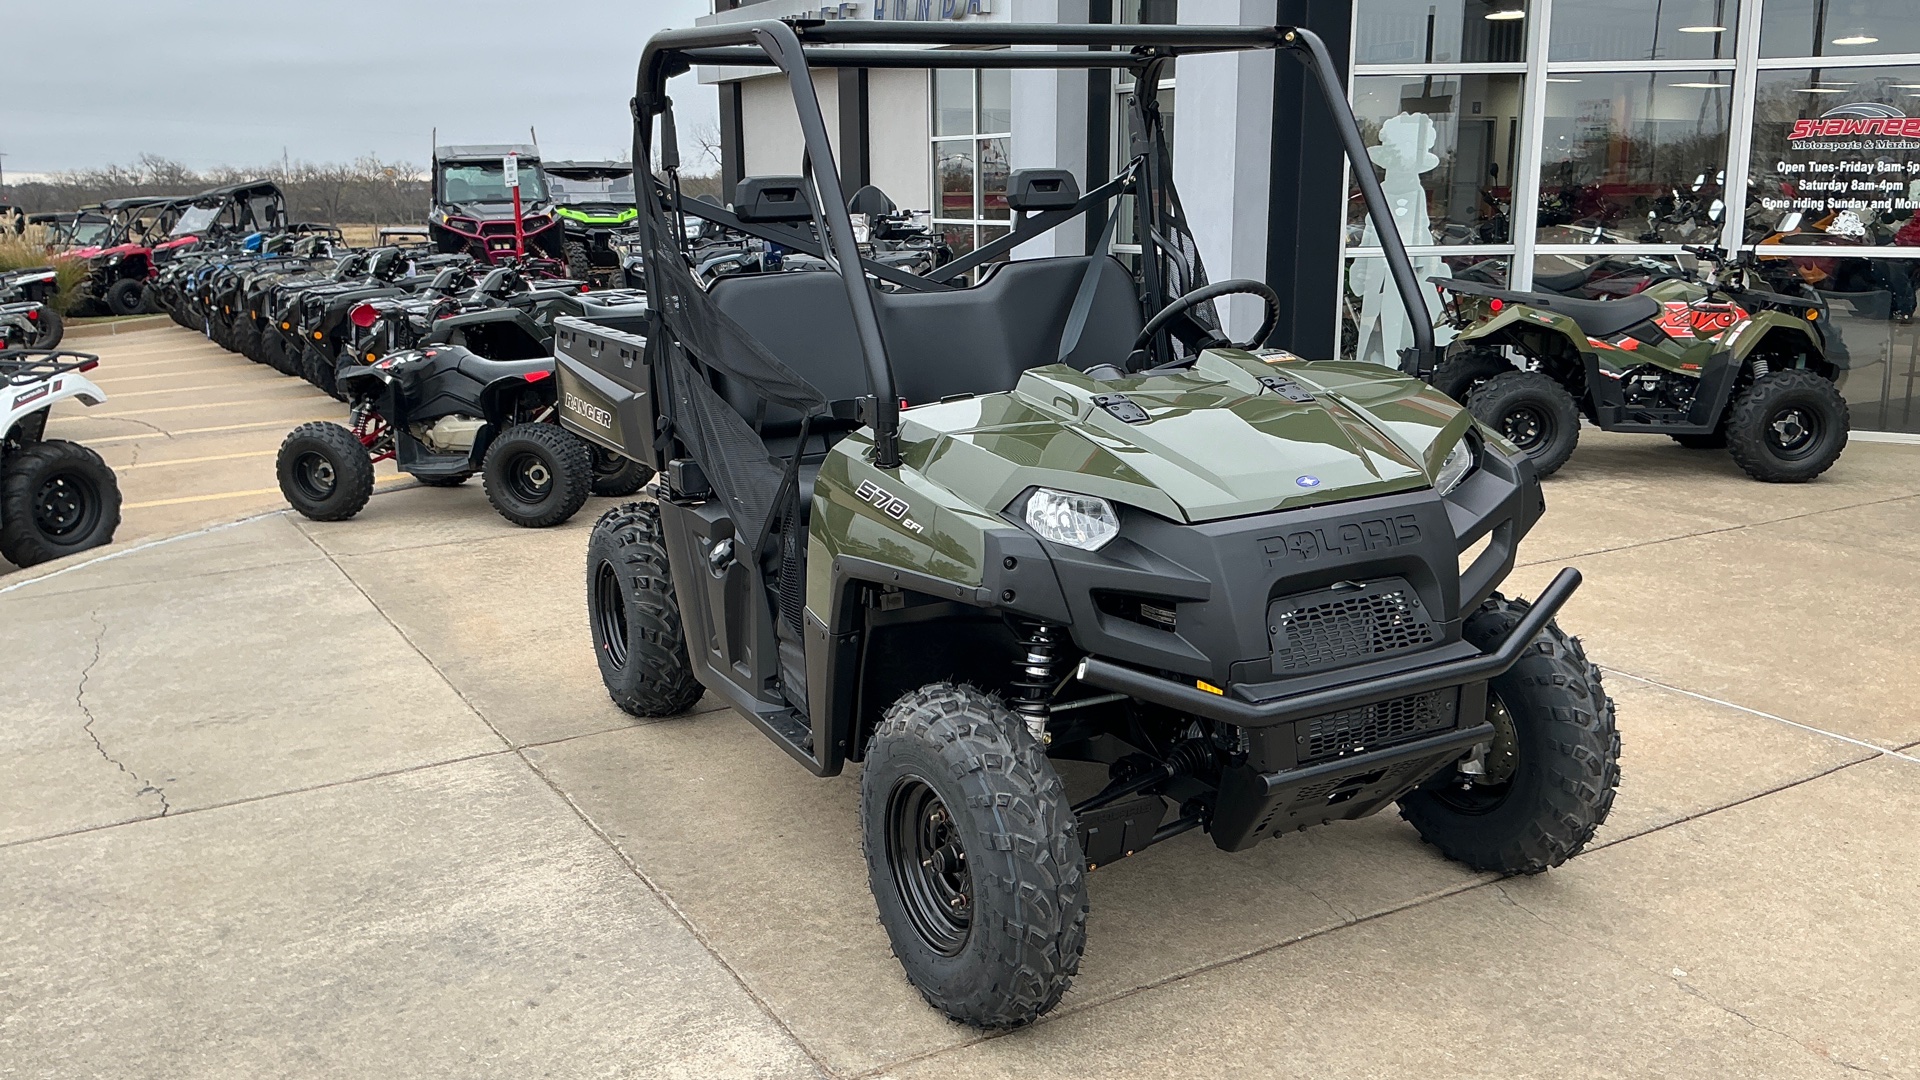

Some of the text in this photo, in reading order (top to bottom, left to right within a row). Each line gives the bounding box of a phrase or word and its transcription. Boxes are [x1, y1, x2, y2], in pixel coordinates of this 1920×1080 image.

[1791, 139, 1920, 151] Motorsports & Marine
[1777, 161, 1805, 174] Open
[1799, 179, 1904, 193] Saturday 8am-4pm
[1762, 197, 1920, 210] Gone riding Sunday and Mon
[565, 392, 612, 429] RANGER
[855, 479, 925, 534] 570 EFI
[1256, 514, 1422, 567] POLARIS
